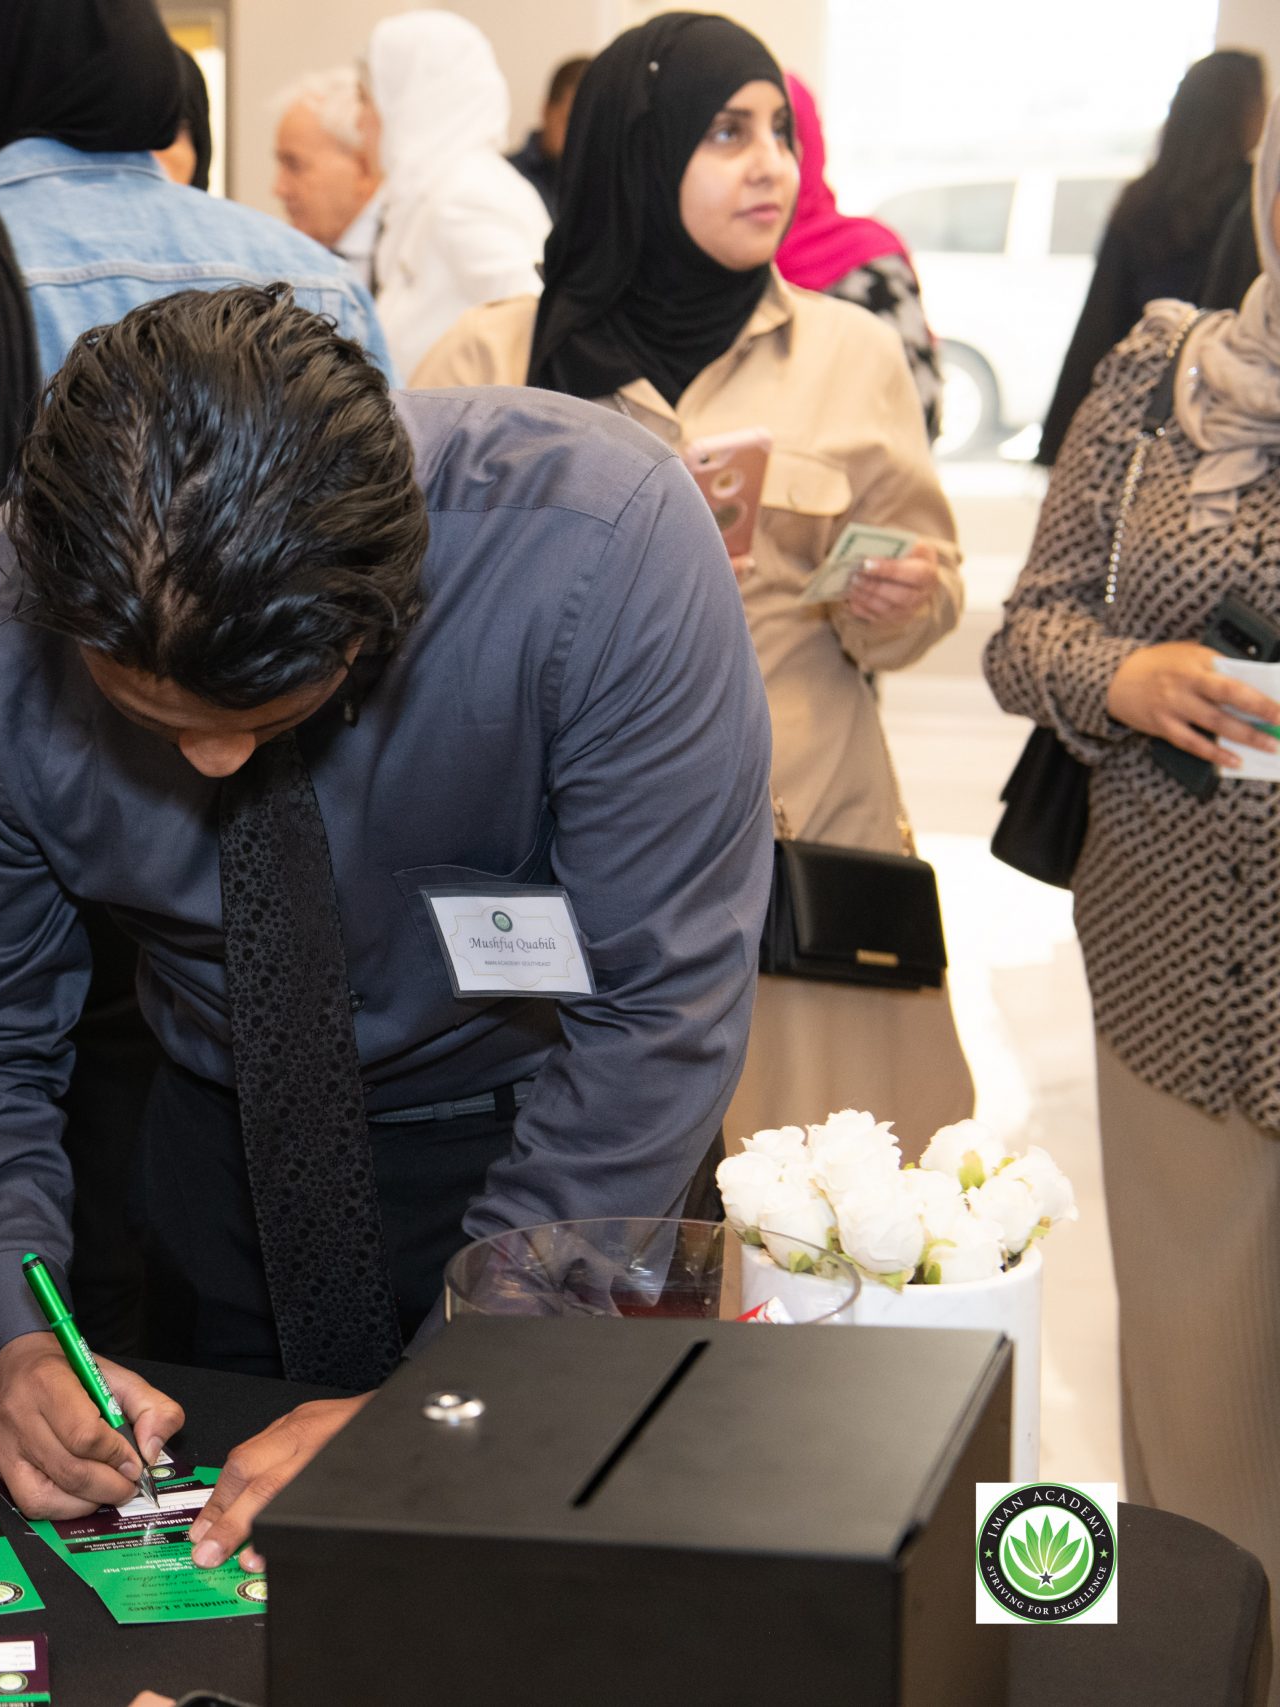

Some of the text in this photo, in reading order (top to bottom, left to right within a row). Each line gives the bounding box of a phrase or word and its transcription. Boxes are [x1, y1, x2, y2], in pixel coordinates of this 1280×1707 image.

[469, 937, 556, 953] Mushfiq Quabili
[155, 1517, 193, 1526] Building
[118, 1522, 147, 1530] Legacy
[184, 1600, 238, 1608] Building
